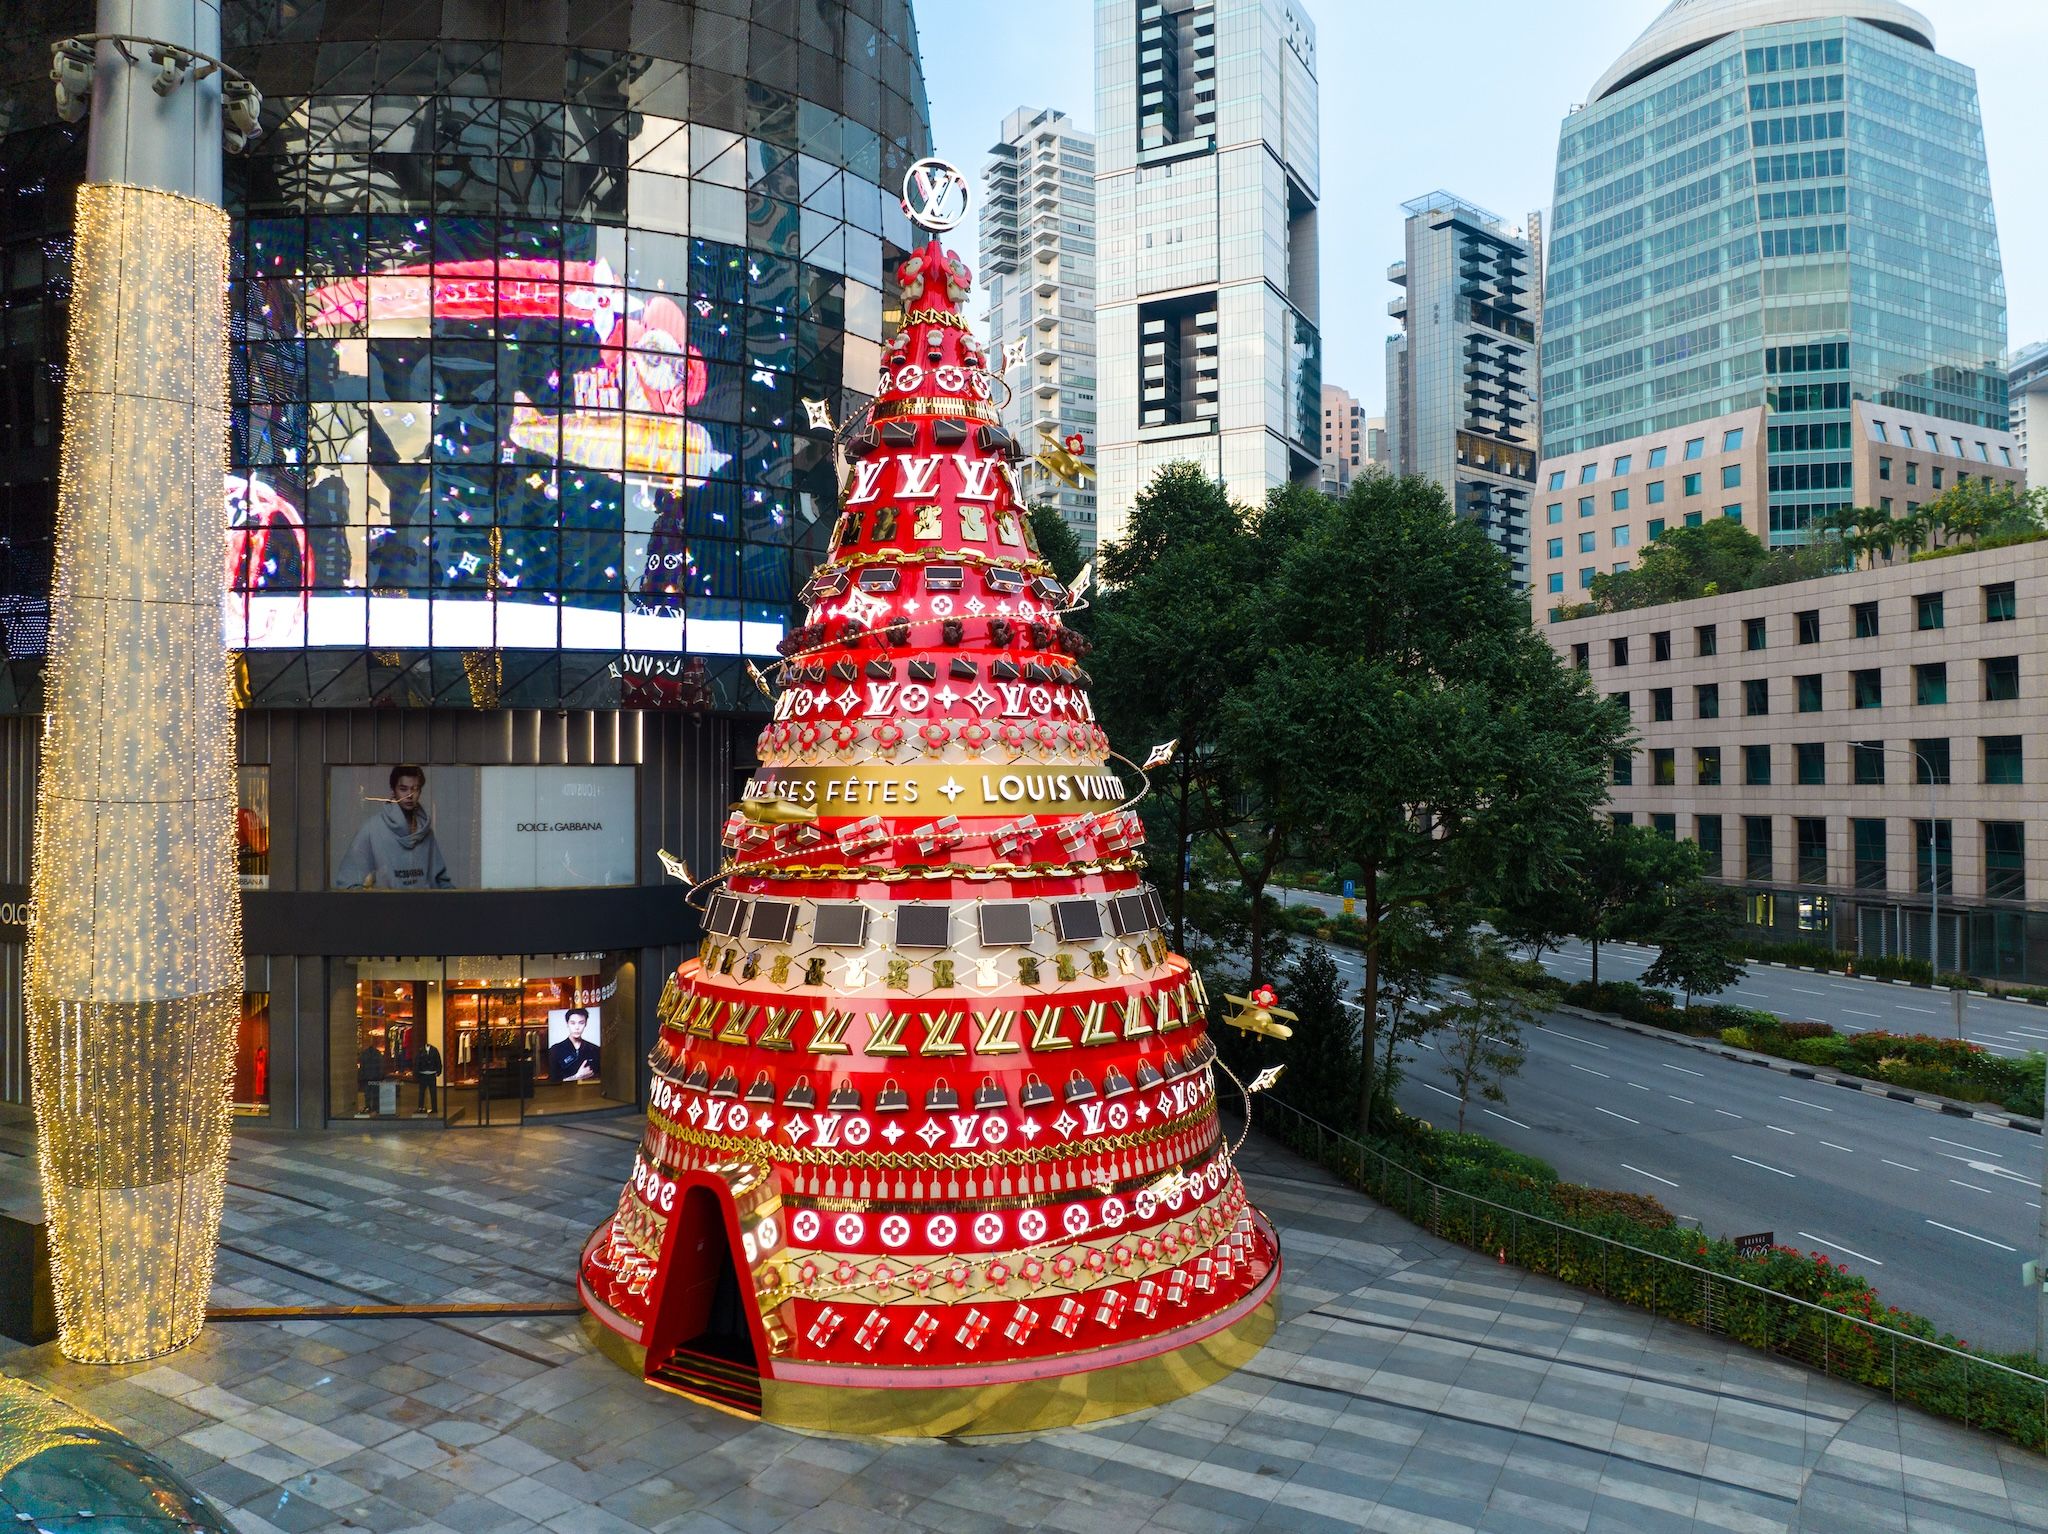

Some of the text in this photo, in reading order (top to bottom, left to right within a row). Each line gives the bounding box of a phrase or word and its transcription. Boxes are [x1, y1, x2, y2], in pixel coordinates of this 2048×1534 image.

[893, 454, 943, 499] LV
[952, 454, 998, 500] LV
[863, 682, 900, 717] LV
[997, 682, 1029, 717] LV
[826, 776, 919, 803] FÊTES
[981, 774, 1072, 802] LOUIS
[517, 823, 549, 832] DOLCE
[555, 822, 602, 832] GABBANA
[703, 1098, 727, 1132] LV
[811, 1113, 842, 1147] LV
[949, 1114, 979, 1148] LV
[1079, 1101, 1106, 1135] LV
